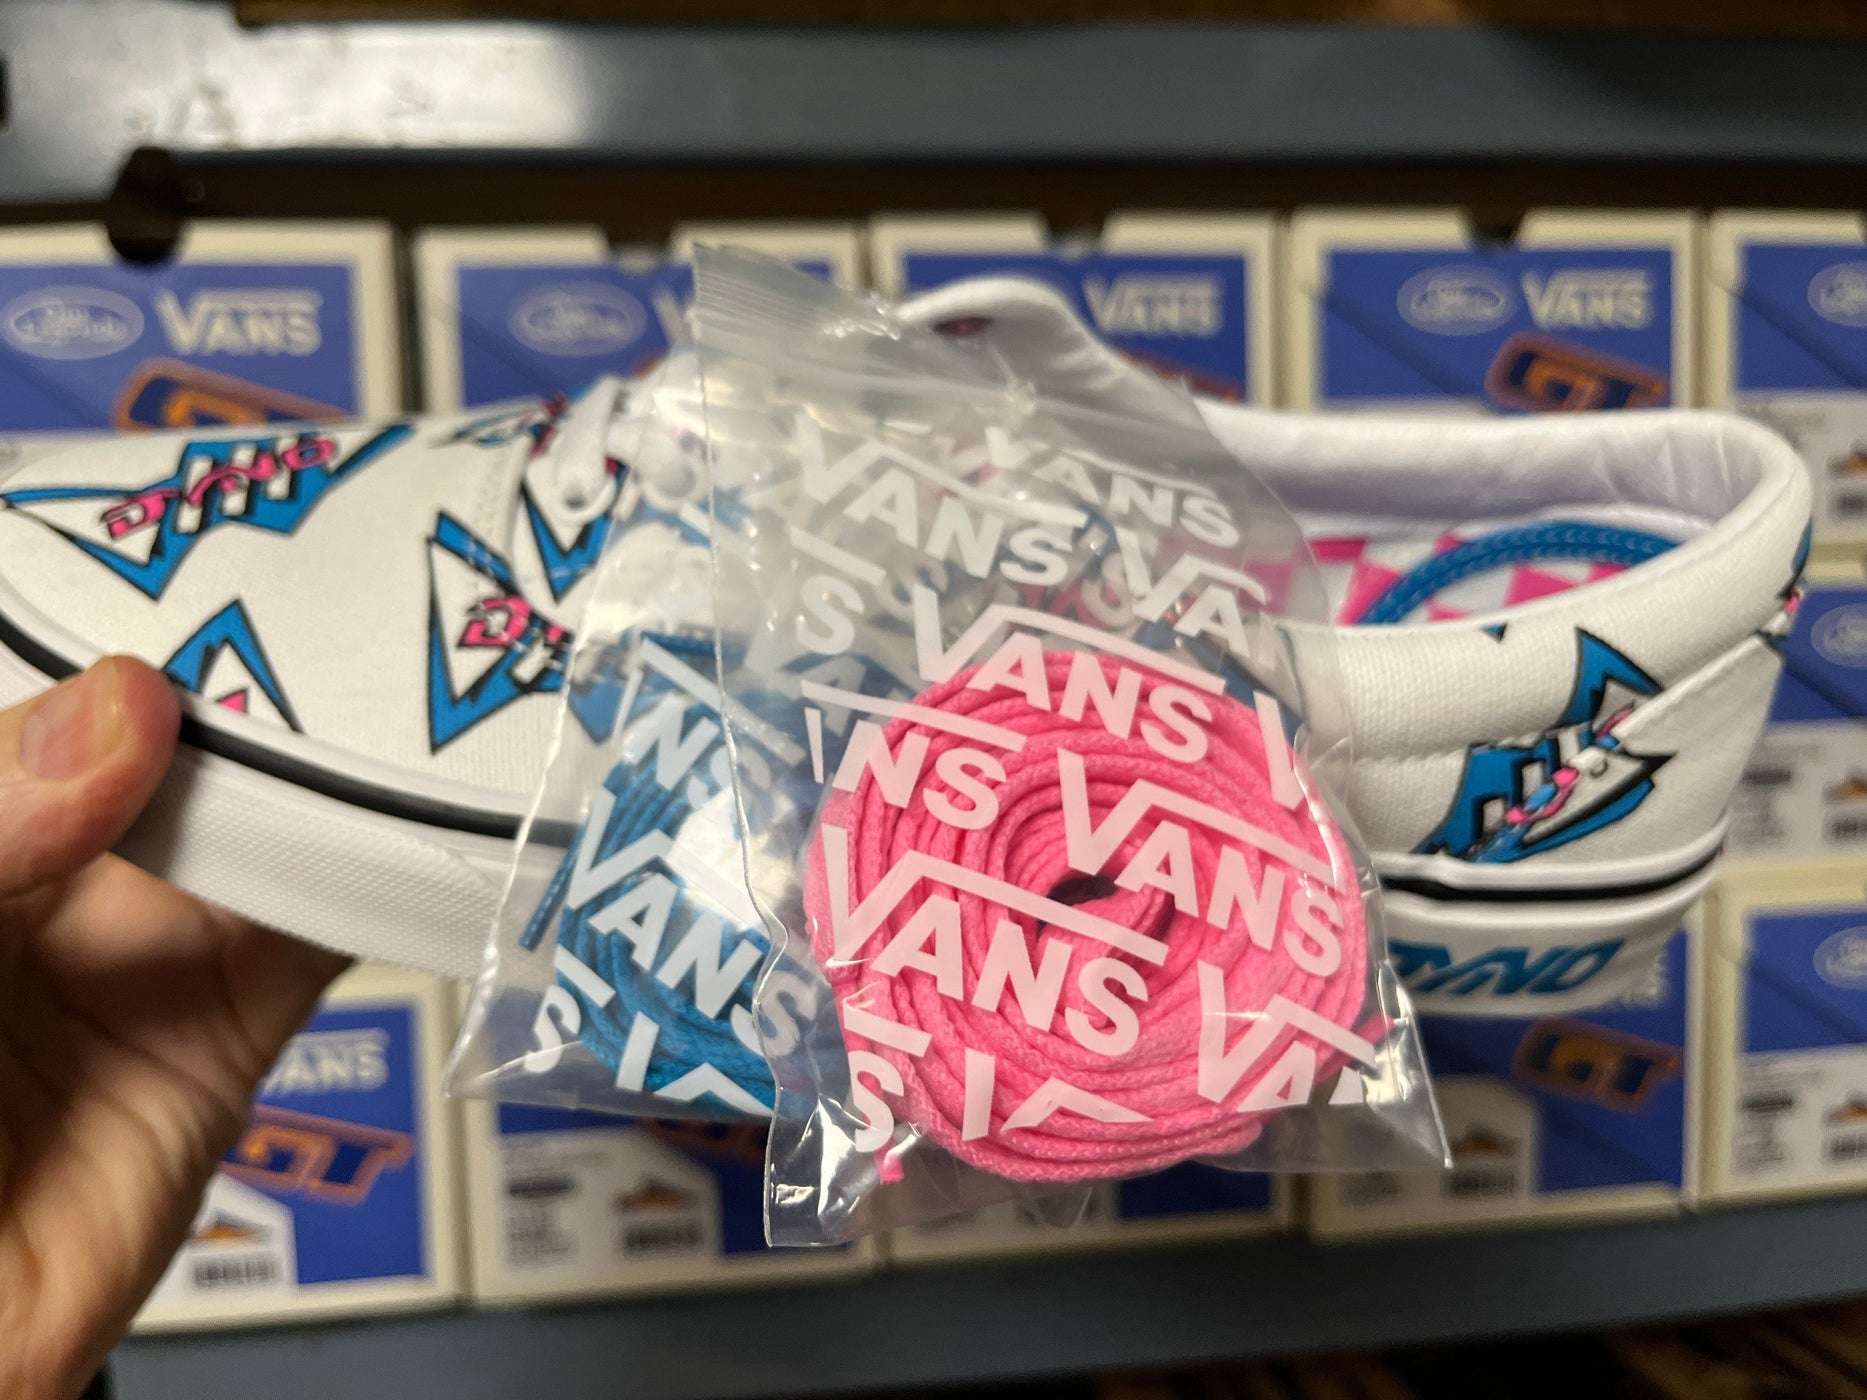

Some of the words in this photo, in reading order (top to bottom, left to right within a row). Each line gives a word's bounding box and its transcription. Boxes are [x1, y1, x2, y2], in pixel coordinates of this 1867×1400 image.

[153, 286, 325, 357] VANS
[1520, 268, 1654, 331] VANS
[796, 412, 1089, 587] VANS
[985, 425, 1241, 549] VANS
[801, 678, 1027, 831] NS
[914, 584, 1227, 765] VANS
[568, 785, 820, 1058] VANS
[821, 823, 1170, 1057] VANS
[1057, 748, 1347, 978] VANS
[258, 1027, 391, 1098] ANS
